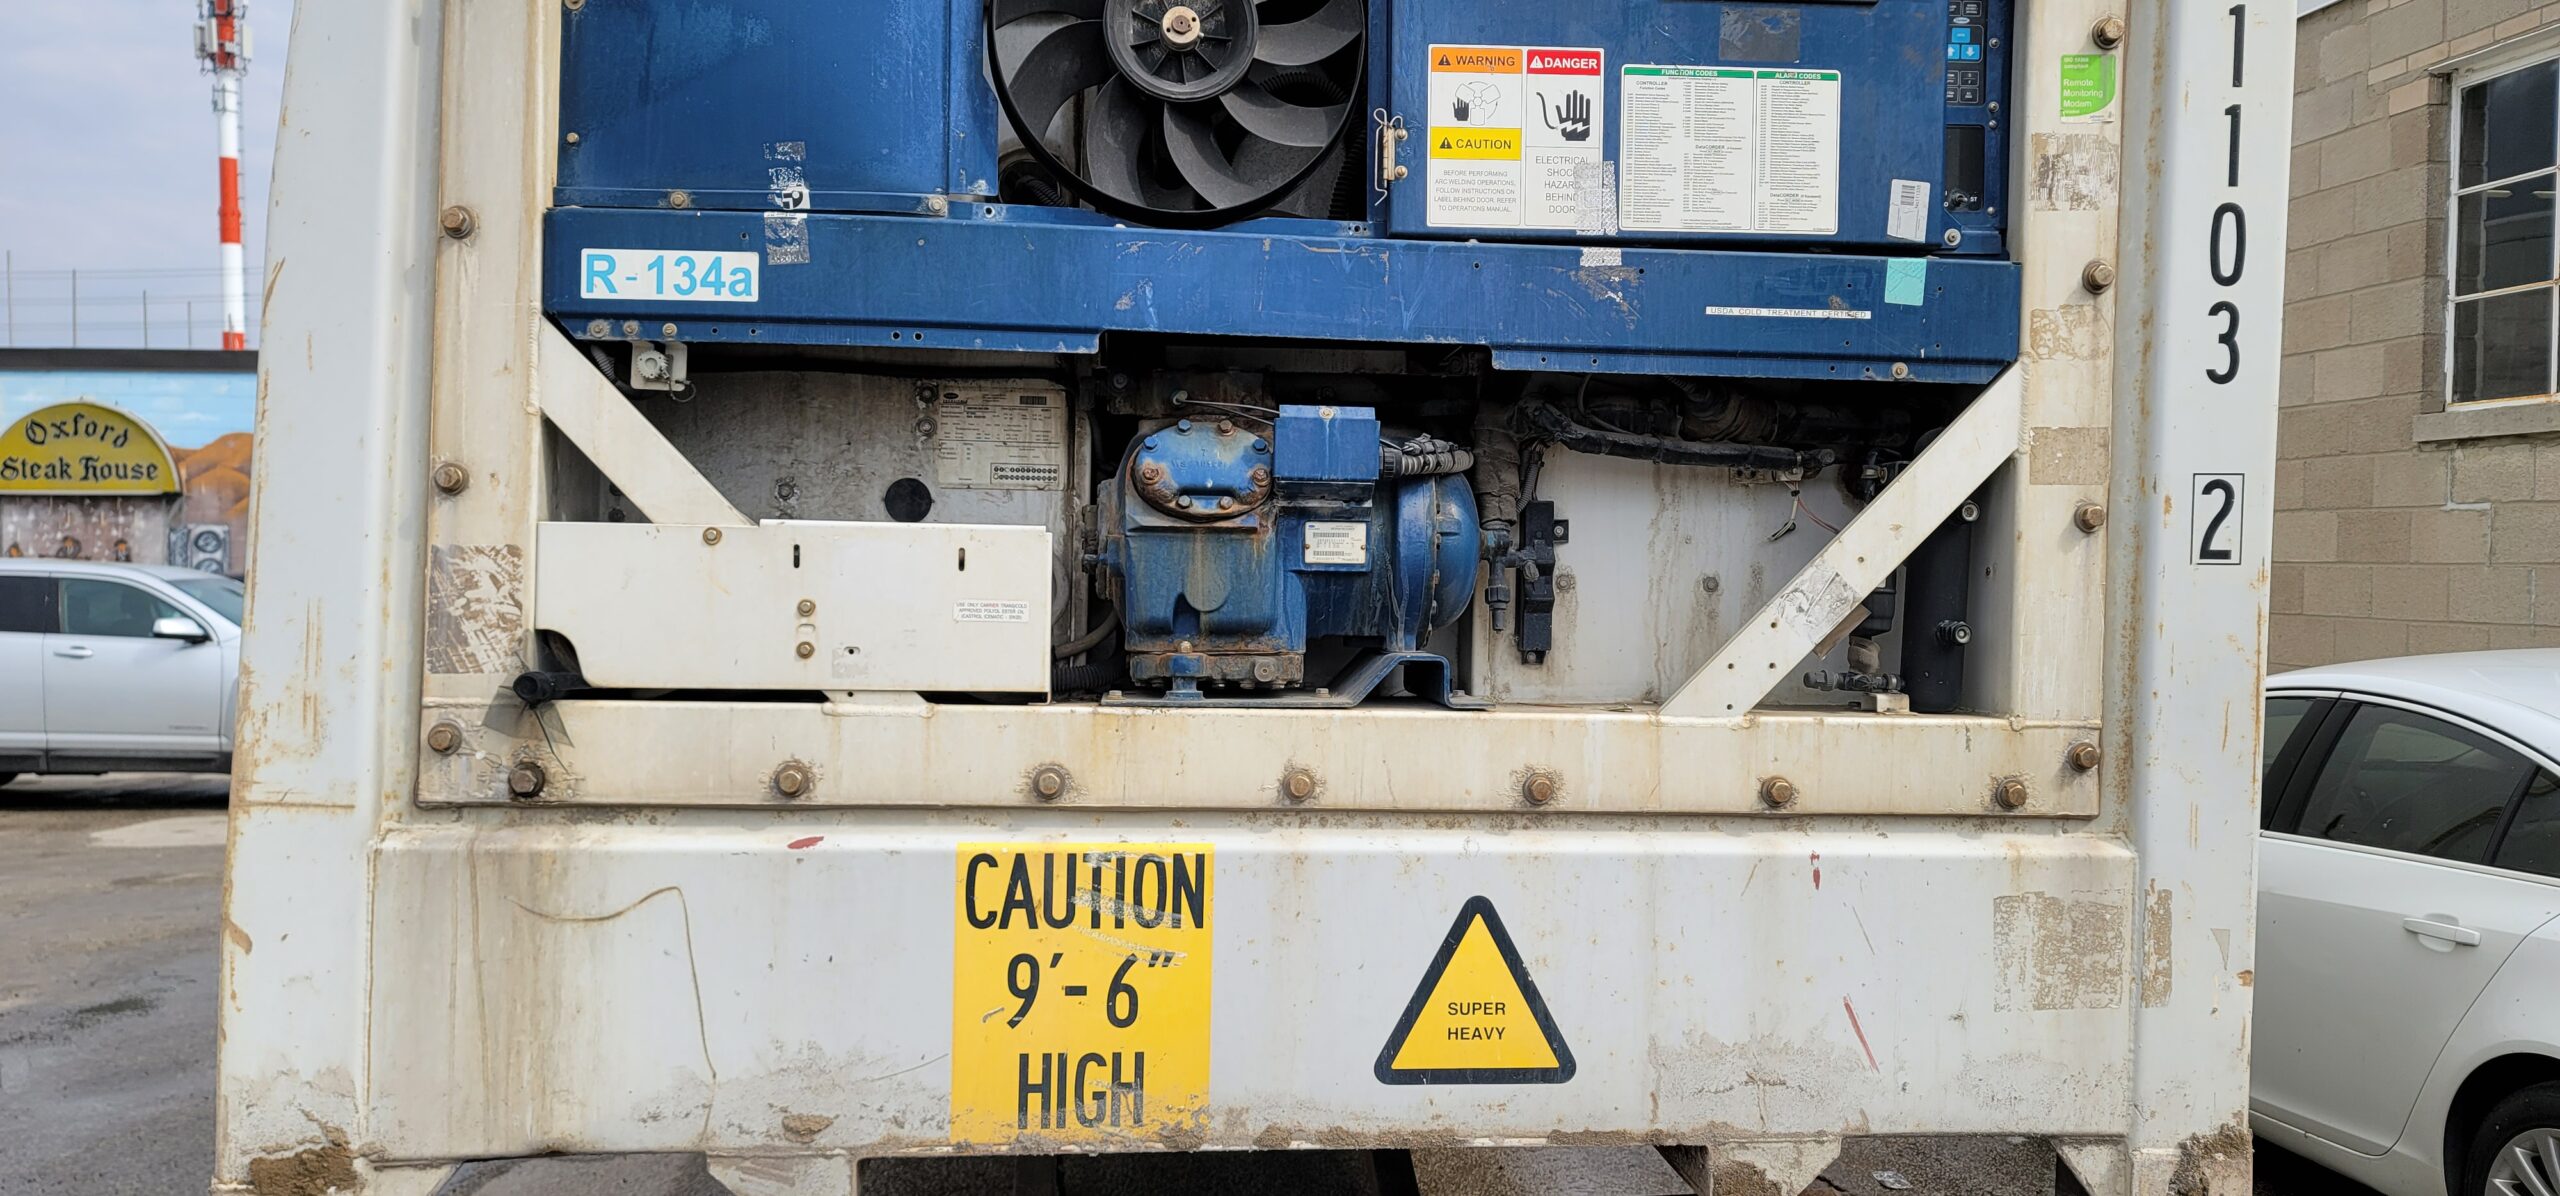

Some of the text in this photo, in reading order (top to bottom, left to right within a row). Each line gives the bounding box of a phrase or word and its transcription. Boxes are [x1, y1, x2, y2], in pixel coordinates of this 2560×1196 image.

[1456, 56, 1516, 66] WARNING
[1544, 56, 1598, 69] DANGER
[2064, 90, 2103, 98] Monitoring
[1456, 139, 1512, 150] CAUTION
[1536, 156, 1589, 165] ELECTRICAL
[1547, 168, 1578, 176] SHOC
[1549, 205, 1575, 213] DOOR
[586, 254, 753, 297] R-134a
[25, 412, 129, 448] Oxford
[0, 456, 158, 482] Steak House
[2200, 478, 2235, 560] 2
[966, 853, 1205, 930] CAUTION
[1448, 1002, 1506, 1015] SUPER
[1448, 1027, 1506, 1040] HEAVY
[1018, 1052, 1144, 1130] HIGH
